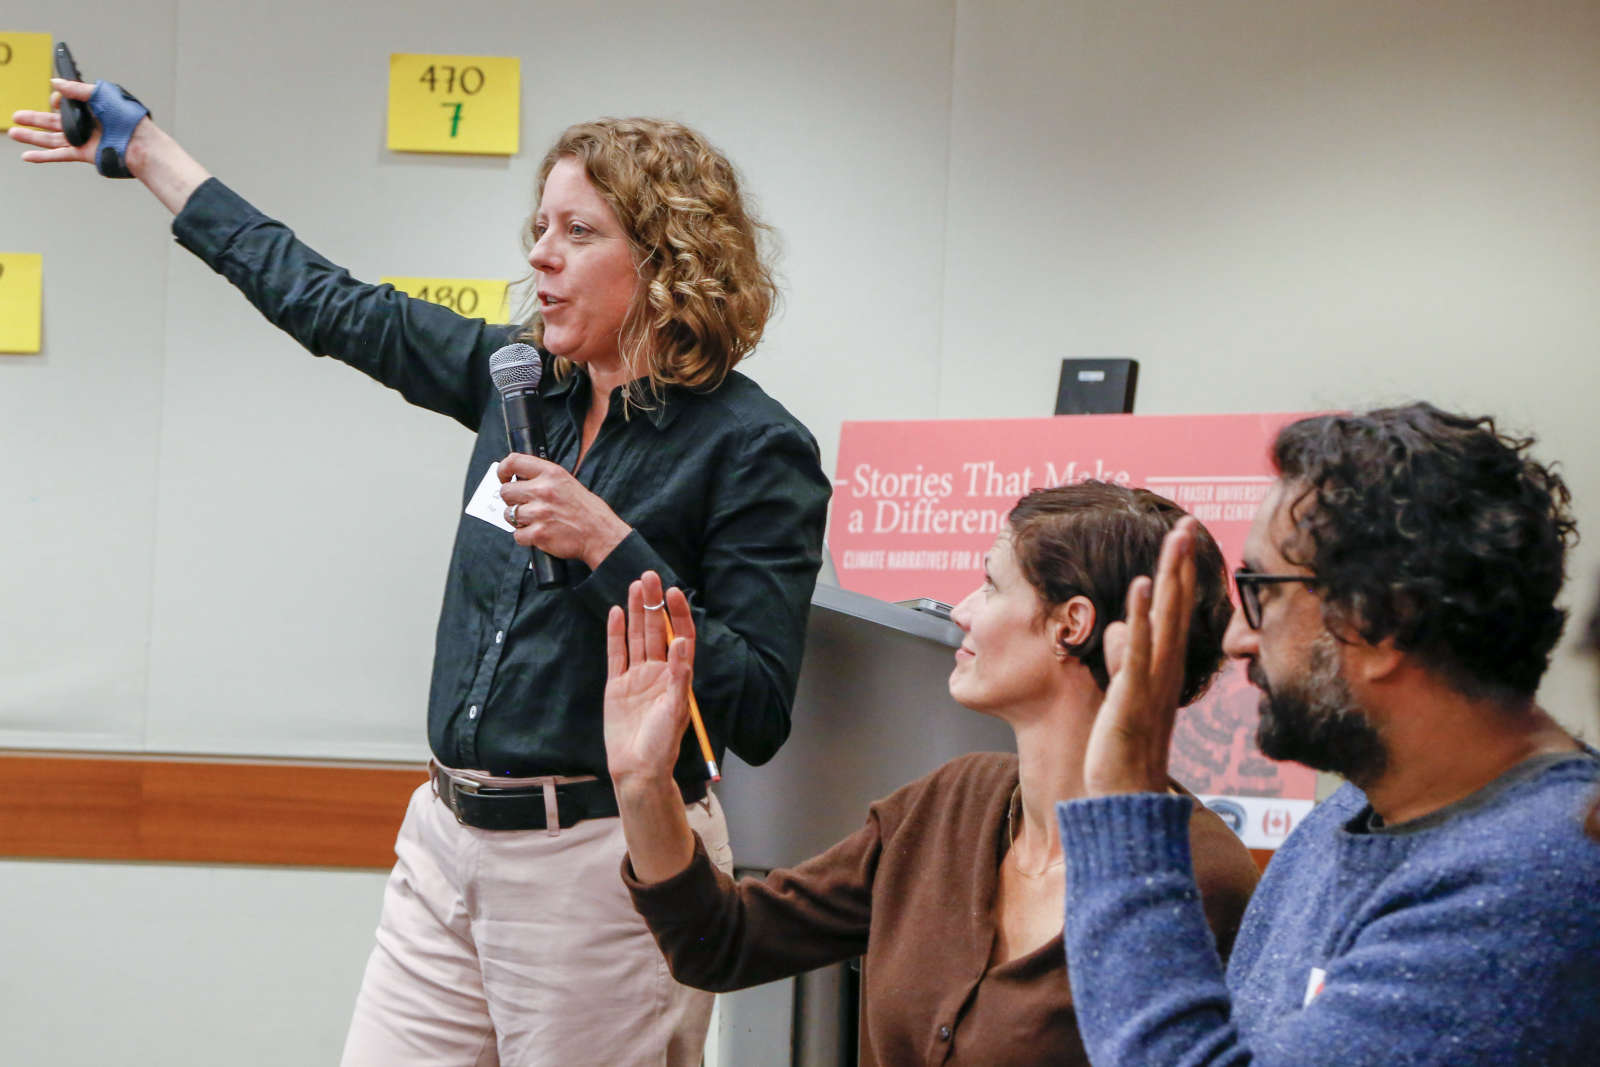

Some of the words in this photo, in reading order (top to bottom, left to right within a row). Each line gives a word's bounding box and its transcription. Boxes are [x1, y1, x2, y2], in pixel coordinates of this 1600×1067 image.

[419, 65, 485, 95] 470
[440, 102, 463, 138] 7
[852, 463, 953, 498] Stories
[963, 461, 1035, 497] That
[848, 508, 864, 533] a
[843, 550, 885, 570] CLIMATE
[888, 551, 949, 570] NARRATIVES
[951, 551, 973, 570] FOR
[973, 551, 982, 570] A
